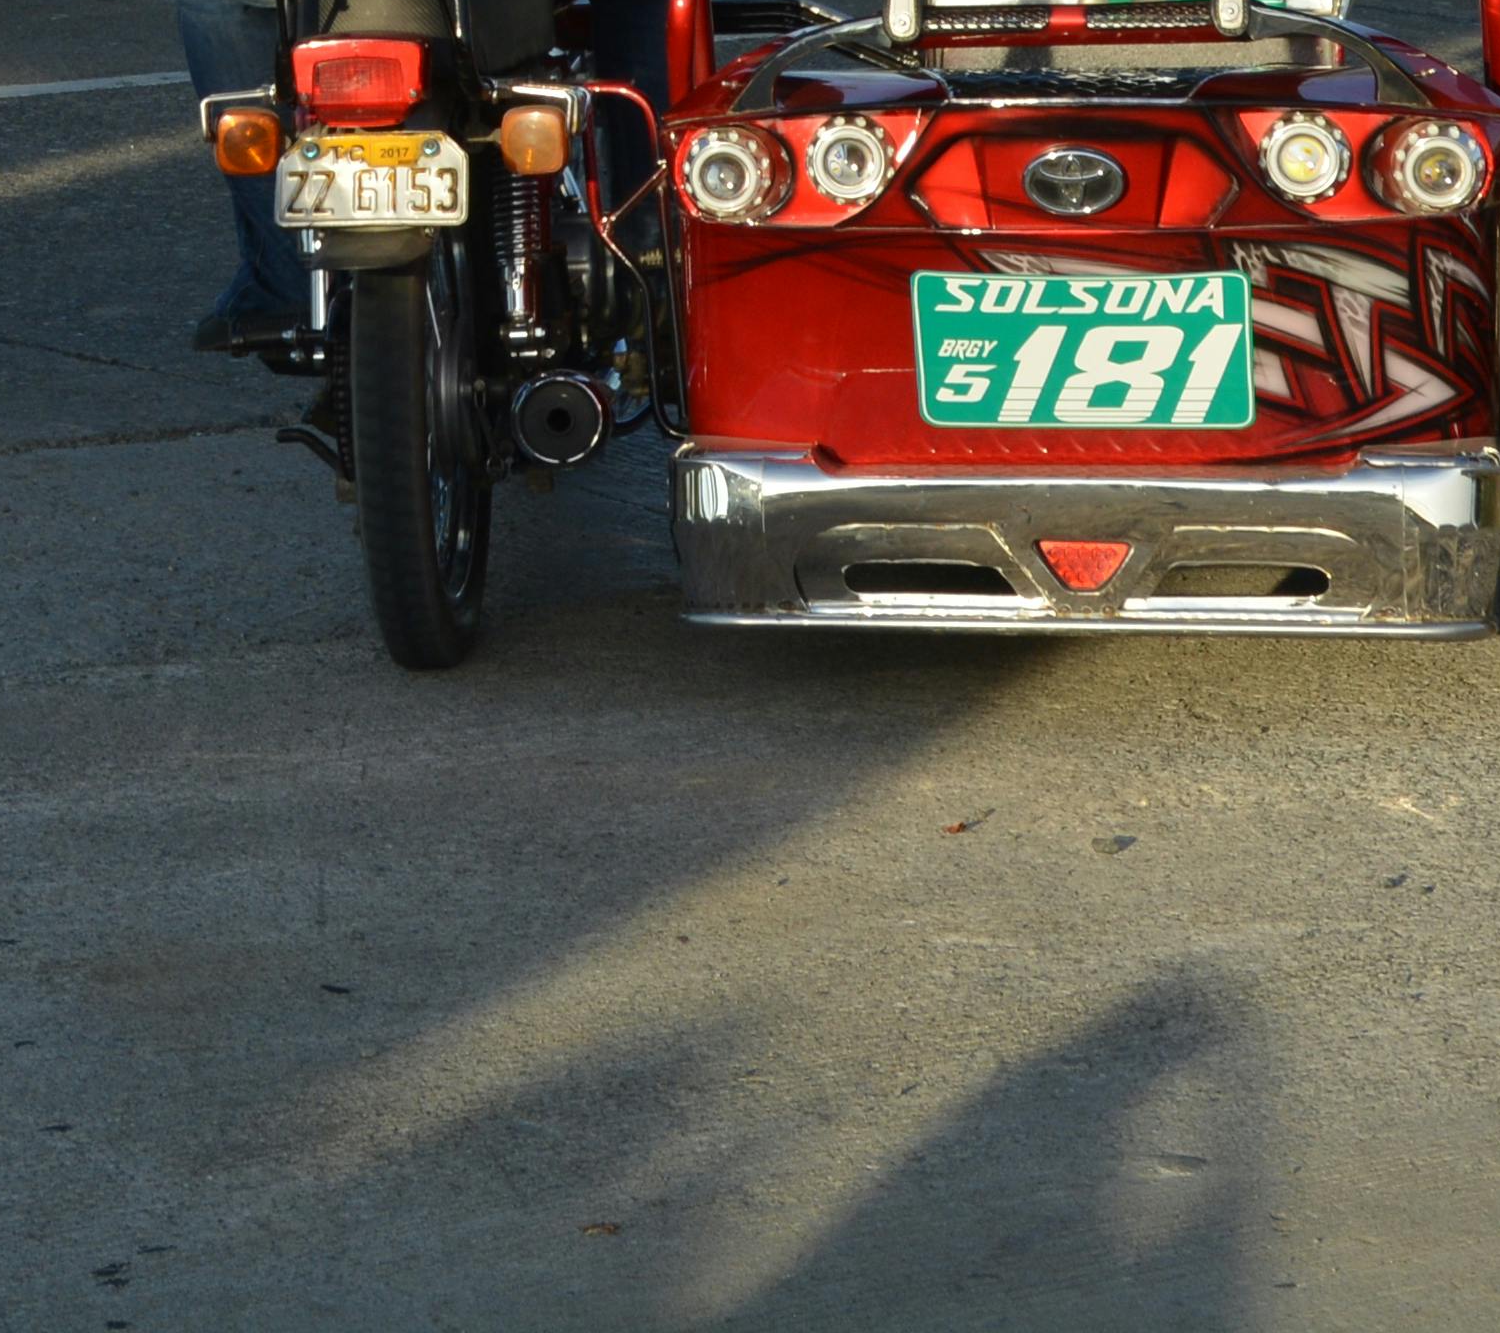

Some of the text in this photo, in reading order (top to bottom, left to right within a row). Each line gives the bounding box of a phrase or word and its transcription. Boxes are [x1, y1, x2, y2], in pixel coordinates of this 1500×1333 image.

[379, 146, 410, 159] 2017
[286, 167, 459, 215] ZZ 6153
[934, 277, 1225, 321] SOLSONA
[937, 338, 998, 360] BRGY
[935, 364, 997, 403] 5
[997, 323, 1244, 424] 181
